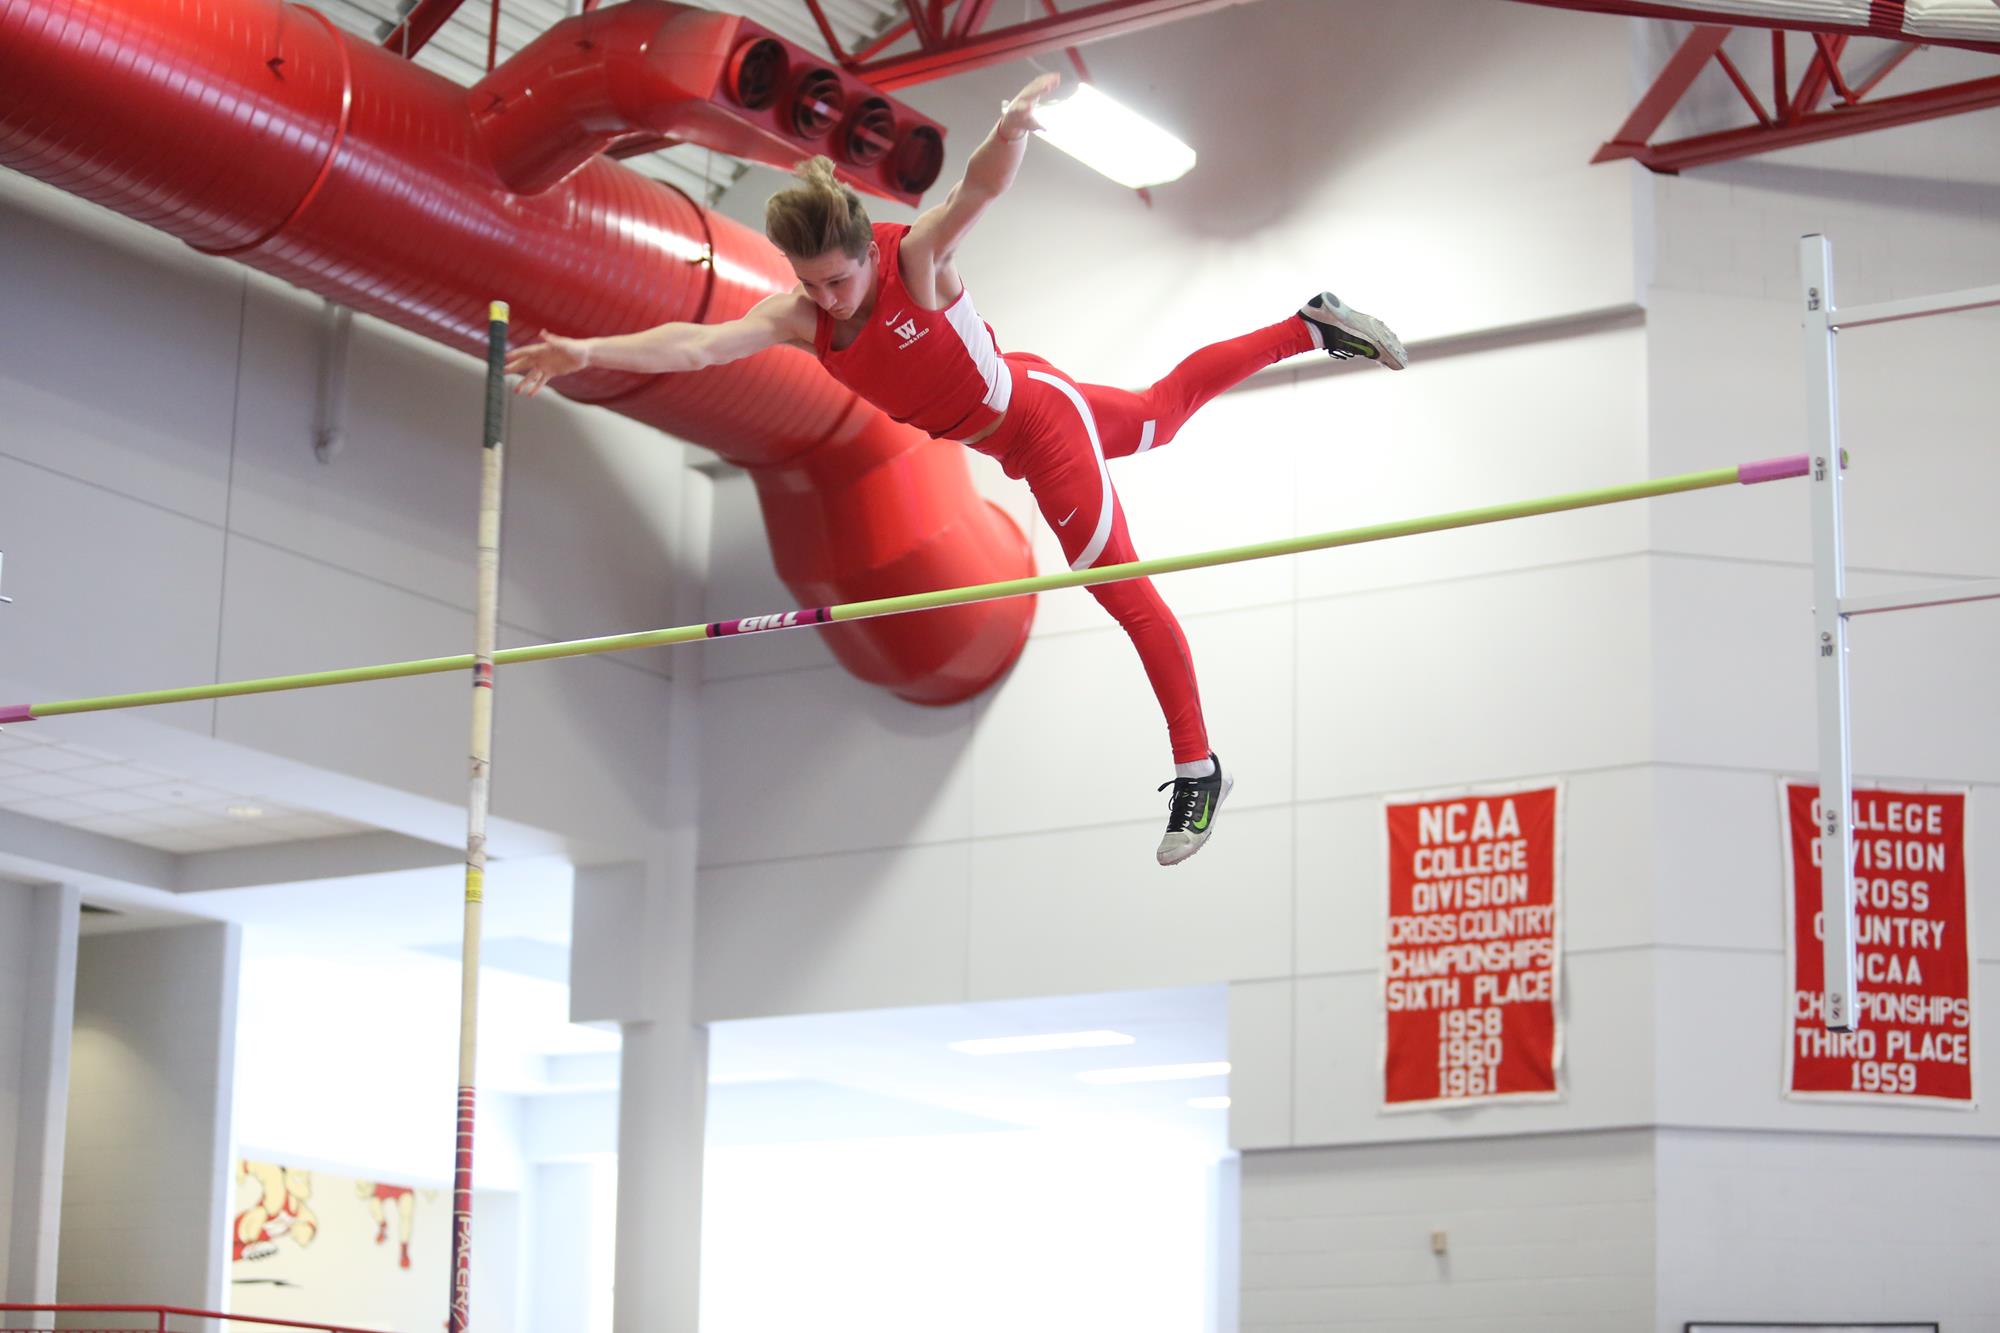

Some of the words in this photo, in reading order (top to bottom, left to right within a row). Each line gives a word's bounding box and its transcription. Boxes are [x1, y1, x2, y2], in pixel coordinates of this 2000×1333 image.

[894, 318, 917, 340] W
[737, 611, 799, 632] GILL
[1418, 798, 1520, 846] NCAA
[1811, 797, 1942, 835] CLLEGE
[1414, 839, 1528, 879] COLLEGE
[1811, 837, 1945, 872] DVISION
[1412, 874, 1528, 913] DIVISION
[1854, 877, 1929, 912] ROSS
[1388, 914, 1457, 945] CROSS
[1459, 904, 1553, 941] COUNTRY
[1813, 911, 1945, 950] CUNTRY
[1387, 938, 1552, 978] CHAMPIONSHIPS
[1388, 977, 1460, 1012] SIXTH
[1473, 970, 1551, 1006] PLACE
[1794, 991, 1969, 1027] CHPIONSHIPS
[1438, 1007, 1503, 1040] 1958
[1438, 1037, 1502, 1069] 1960
[1797, 1027, 1876, 1059] THIRD
[1886, 1030, 1968, 1064] PLACE
[1438, 1066, 1498, 1098] 1961
[1851, 1061, 1917, 1093] 1959
